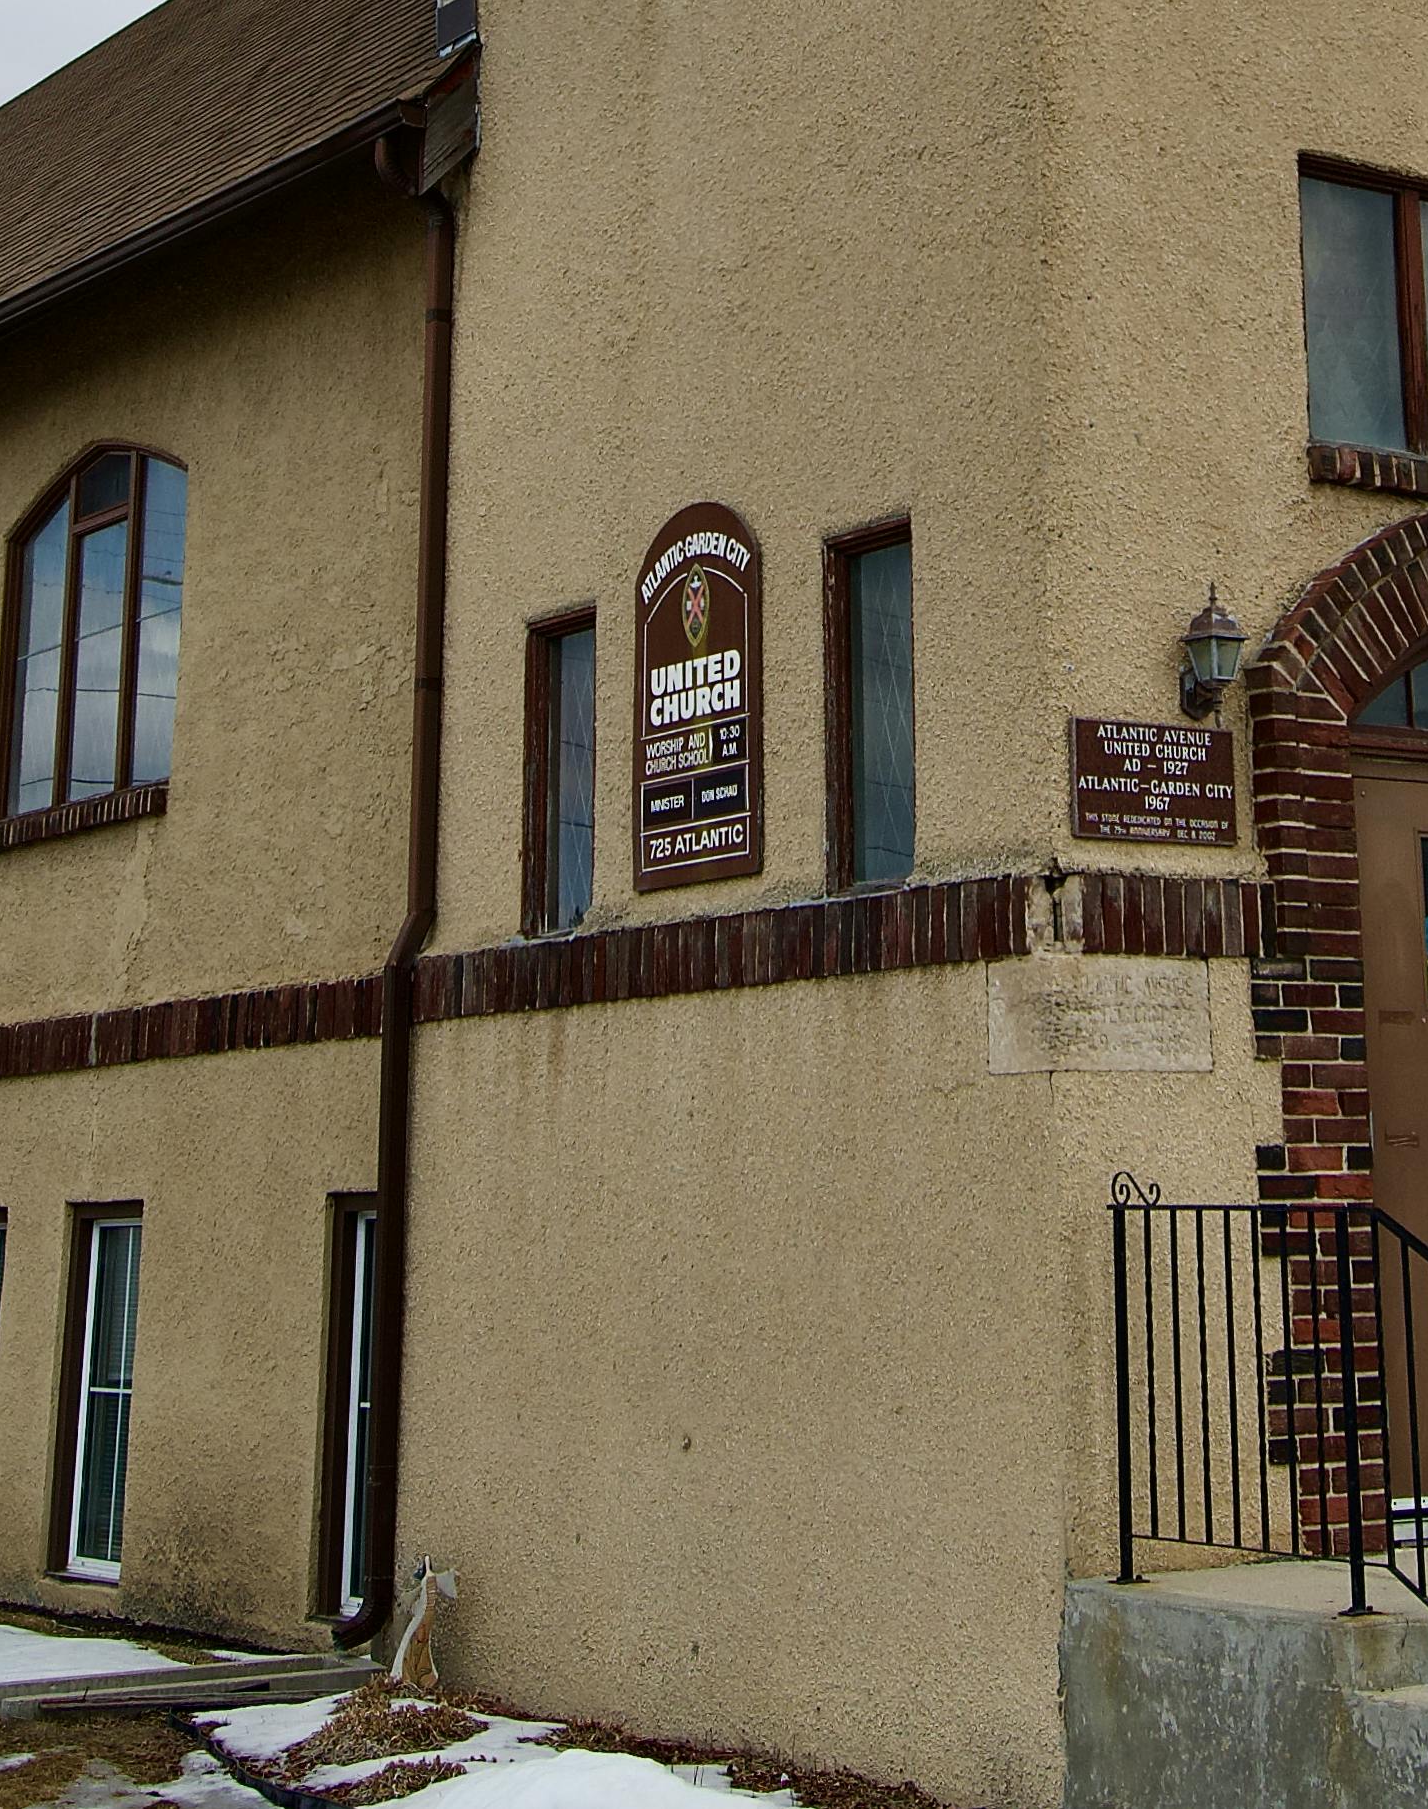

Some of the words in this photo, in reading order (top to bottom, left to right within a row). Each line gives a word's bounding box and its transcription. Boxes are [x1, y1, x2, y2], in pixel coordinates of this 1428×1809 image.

[726, 538, 750, 573] CITY
[651, 649, 741, 696] UNITED
[650, 680, 741, 727] CHURCH
[720, 725, 740, 740] 10:30
[1097, 725, 1158, 741] ATLANTIC
[1164, 731, 1212, 746] AVENUE
[646, 737, 684, 759] WORSHIP
[688, 732, 706, 750] AND
[1104, 741, 1150, 757] UNITED
[1155, 744, 1207, 761] CHURCH
[646, 754, 677, 776] CHURCH
[678, 749, 709, 769] SCHOOL
[1124, 759, 1141, 772] AD
[1163, 761, 1189, 775] 1927
[1206, 784, 1234, 800] CITY
[651, 795, 685, 813] MINISTER
[1145, 796, 1171, 811] 1967
[650, 839, 672, 860] 725
[675, 824, 744, 855] ATLANTIC
